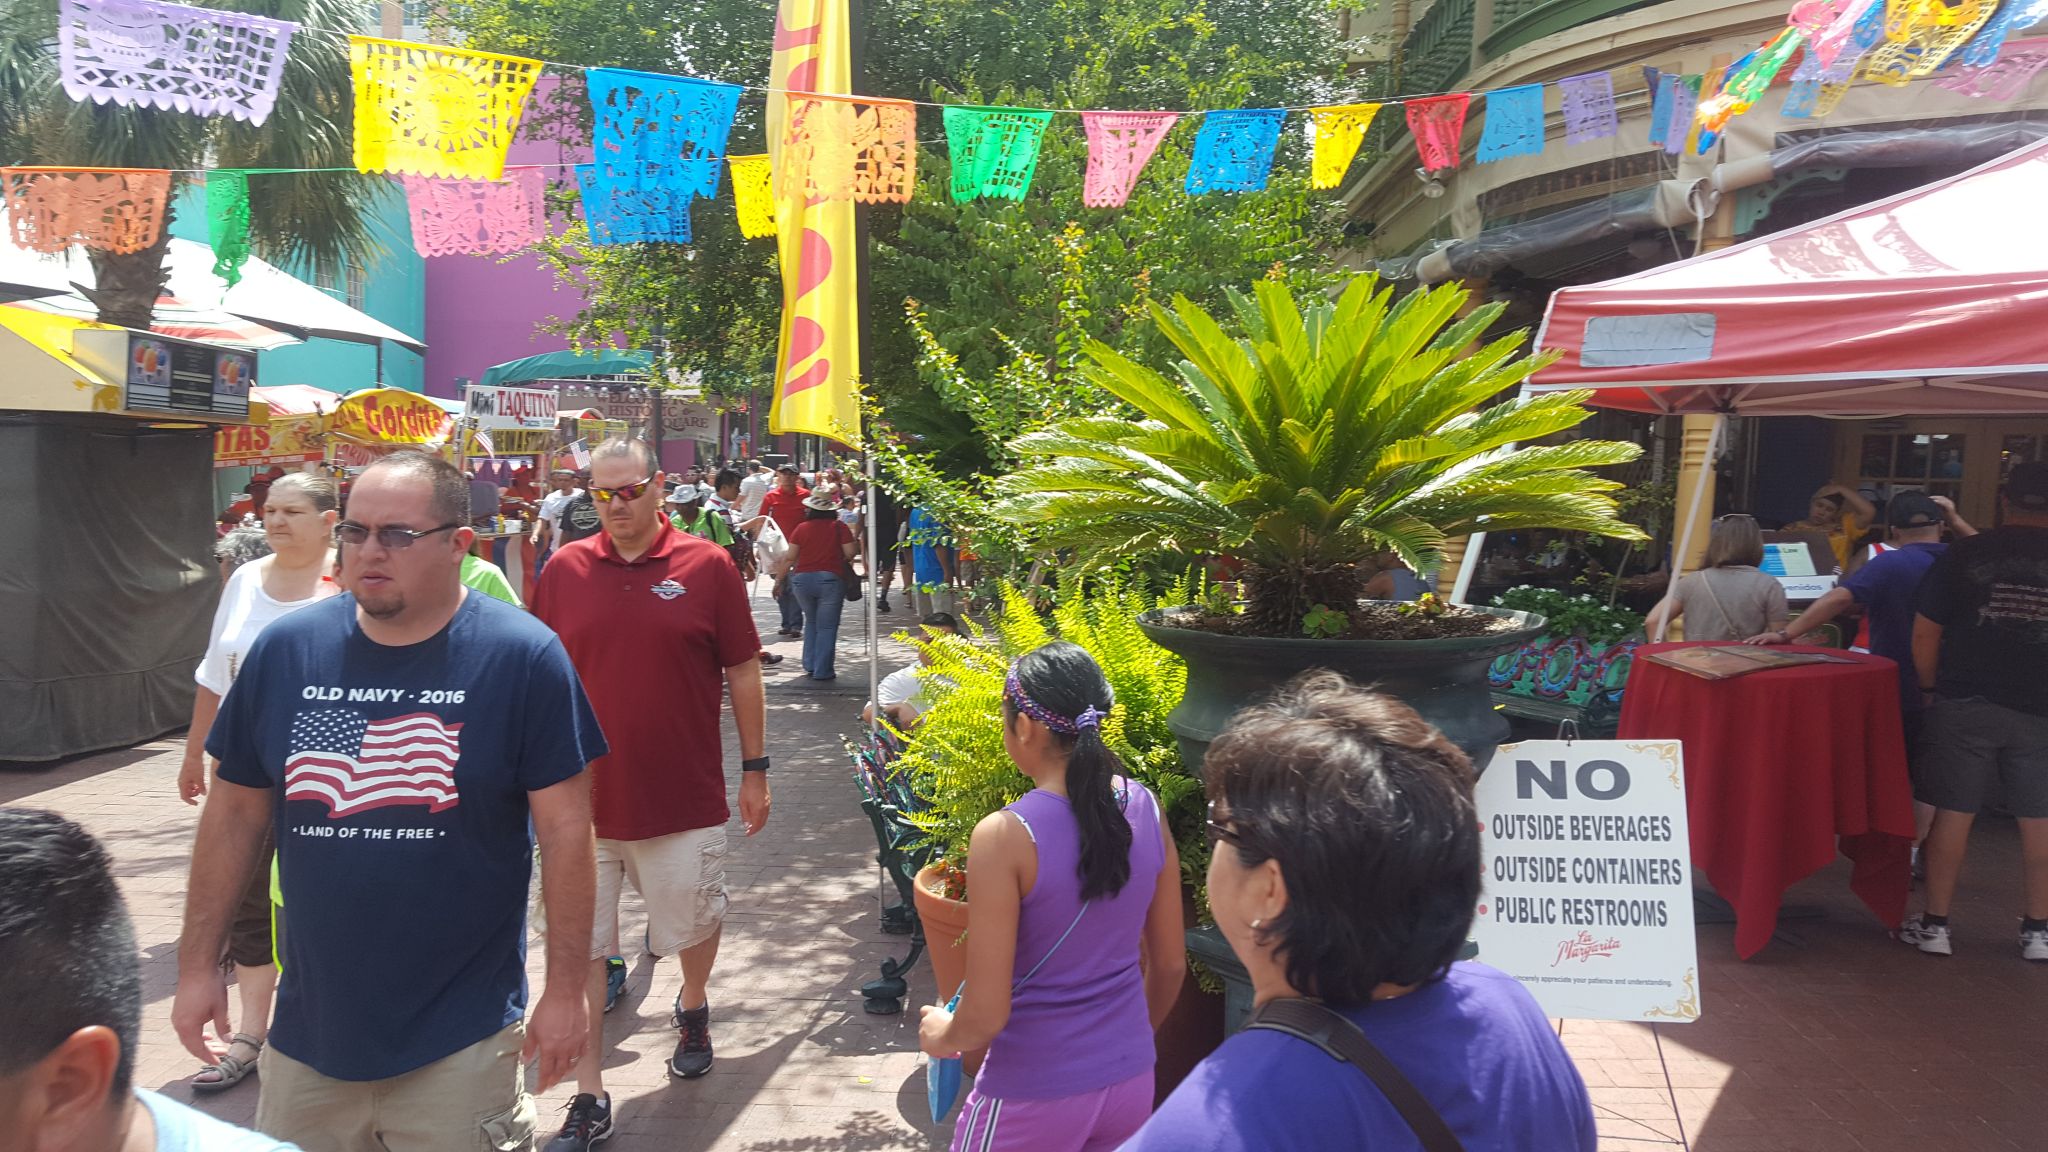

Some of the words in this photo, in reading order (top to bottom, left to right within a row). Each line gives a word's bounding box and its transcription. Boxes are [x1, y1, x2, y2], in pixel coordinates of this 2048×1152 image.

[497, 390, 556, 425] TAQUITOS
[608, 405, 677, 417] HISTOIC
[1785, 583, 1824, 591] venidos
[302, 685, 344, 701] OLD
[347, 688, 405, 702] NAVY
[418, 689, 466, 704] 2016
[1515, 759, 1631, 801] NO
[300, 825, 334, 837] LAND
[338, 827, 358, 838] OF
[363, 828, 392, 839] THE
[396, 828, 435, 839] FREE
[1492, 813, 1565, 841] OUTSIDE
[1570, 815, 1672, 842] BEVERAGES
[1494, 855, 1568, 884] OUTSIDE
[1572, 857, 1682, 886] CONTAINERS
[1495, 896, 1556, 924] PUBLIC
[1562, 898, 1668, 927] RESTROOMS
[1577, 930, 1597, 945] La
[1551, 936, 1622, 967] Margarita
[1541, 976, 1571, 984] appreciate
[1588, 977, 1613, 985] patience
